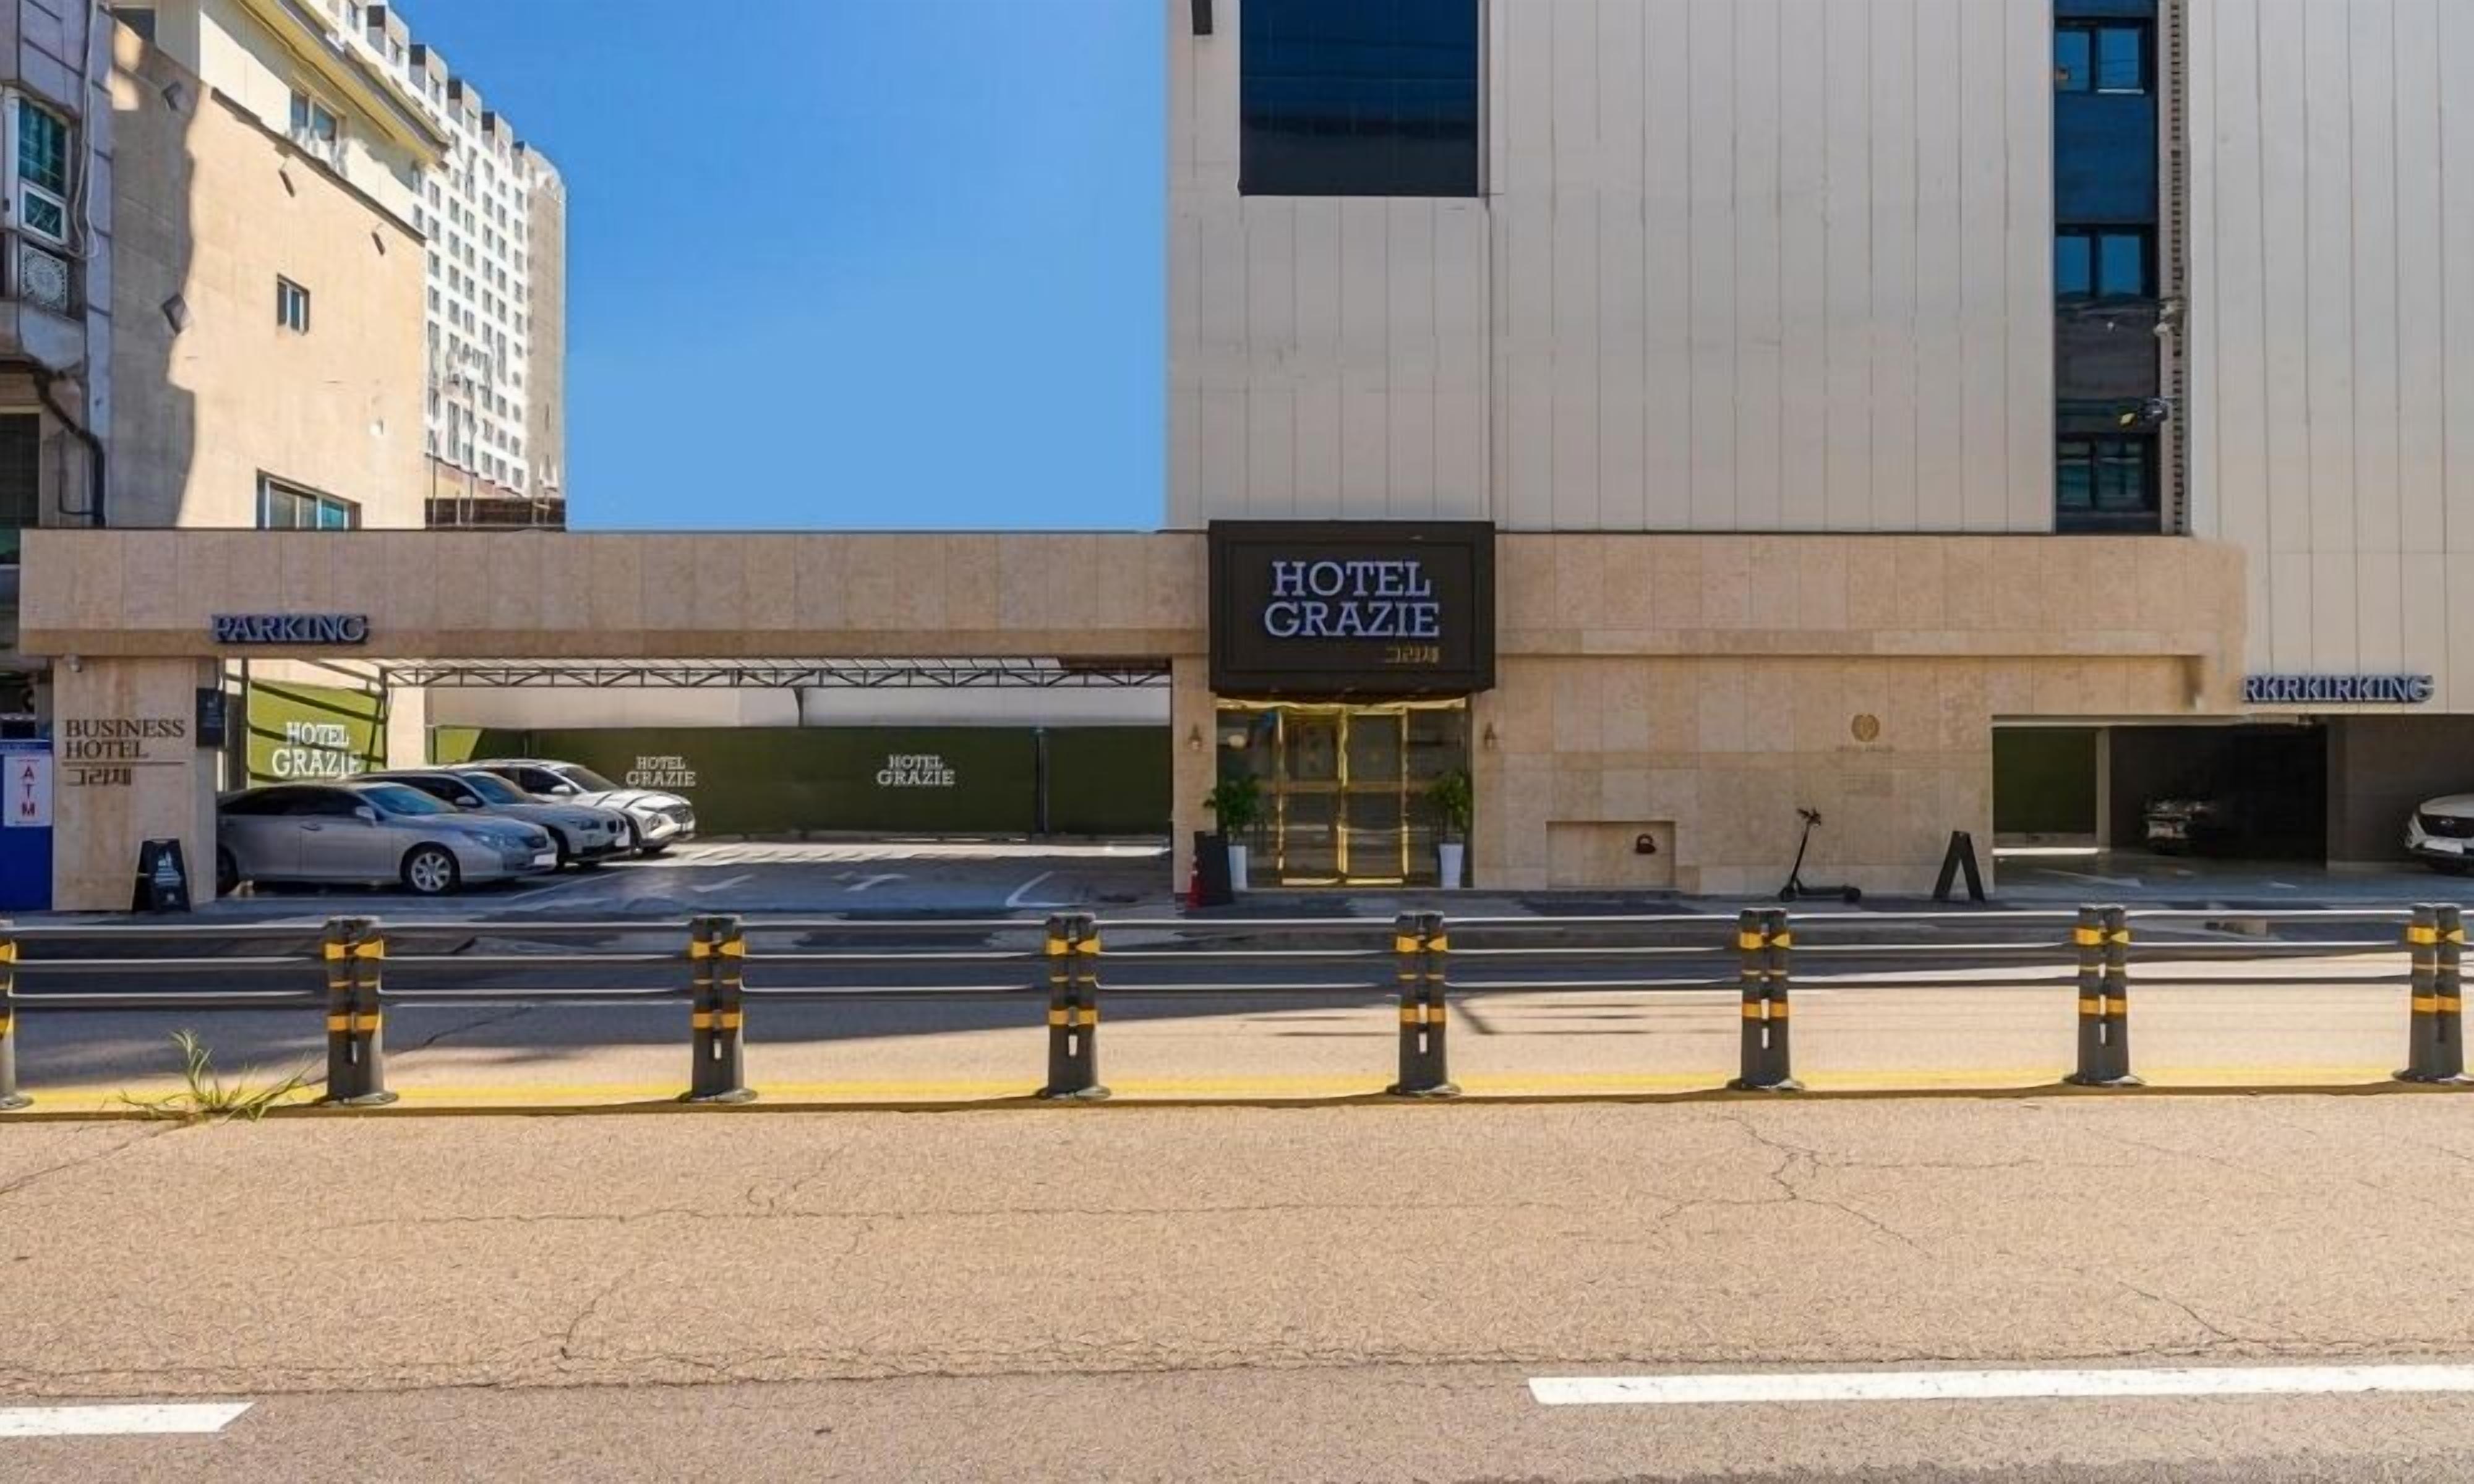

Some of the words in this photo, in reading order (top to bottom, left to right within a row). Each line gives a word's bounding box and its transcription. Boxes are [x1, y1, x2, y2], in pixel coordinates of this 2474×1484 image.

[1272, 561, 1432, 597] HOTEL
[212, 613, 368, 644] PARKING
[1264, 600, 1440, 638] GRAZIE
[66, 719, 185, 738] BUSINESS
[286, 721, 349, 746] HOTEL
[66, 740, 150, 759] HOTEL
[272, 747, 367, 779] GRAZIE
[635, 756, 686, 770] HOTEL
[888, 754, 943, 770] HOTEL
[625, 770, 696, 787] GRAZIE
[876, 769, 956, 787] GRAZIE
[20, 765, 35, 817] ATM
